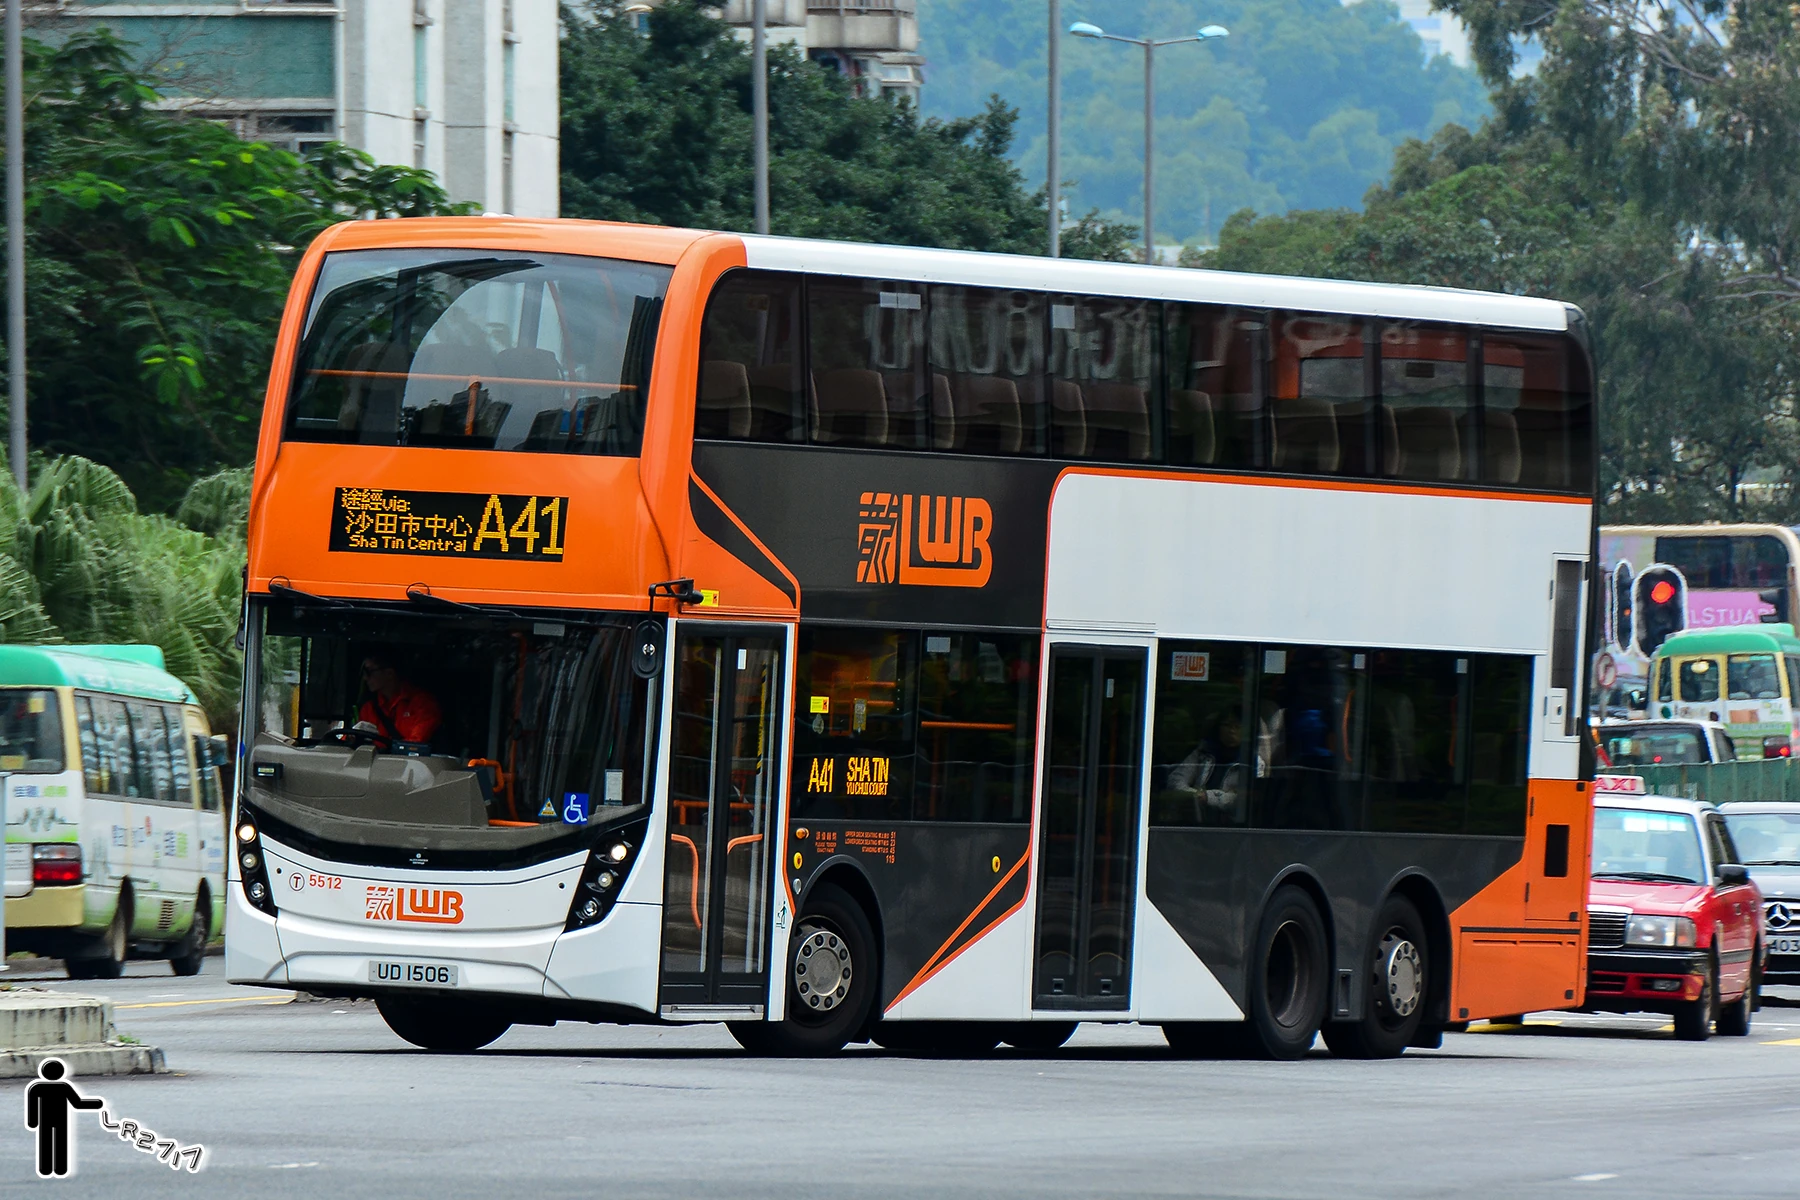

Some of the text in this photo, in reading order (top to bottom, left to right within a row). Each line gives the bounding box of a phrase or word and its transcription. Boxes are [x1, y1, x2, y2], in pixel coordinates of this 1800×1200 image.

[345, 510, 473, 538] 沙田市中心
[473, 494, 564, 555] A41
[349, 534, 467, 553] Sha Tin Central
[807, 757, 834, 793] A41
[846, 757, 889, 782] SHA TIN
[885, 854, 896, 864] 119
[309, 874, 342, 890] 5512
[397, 888, 464, 924] LWB
[378, 963, 450, 983] UD 1506
